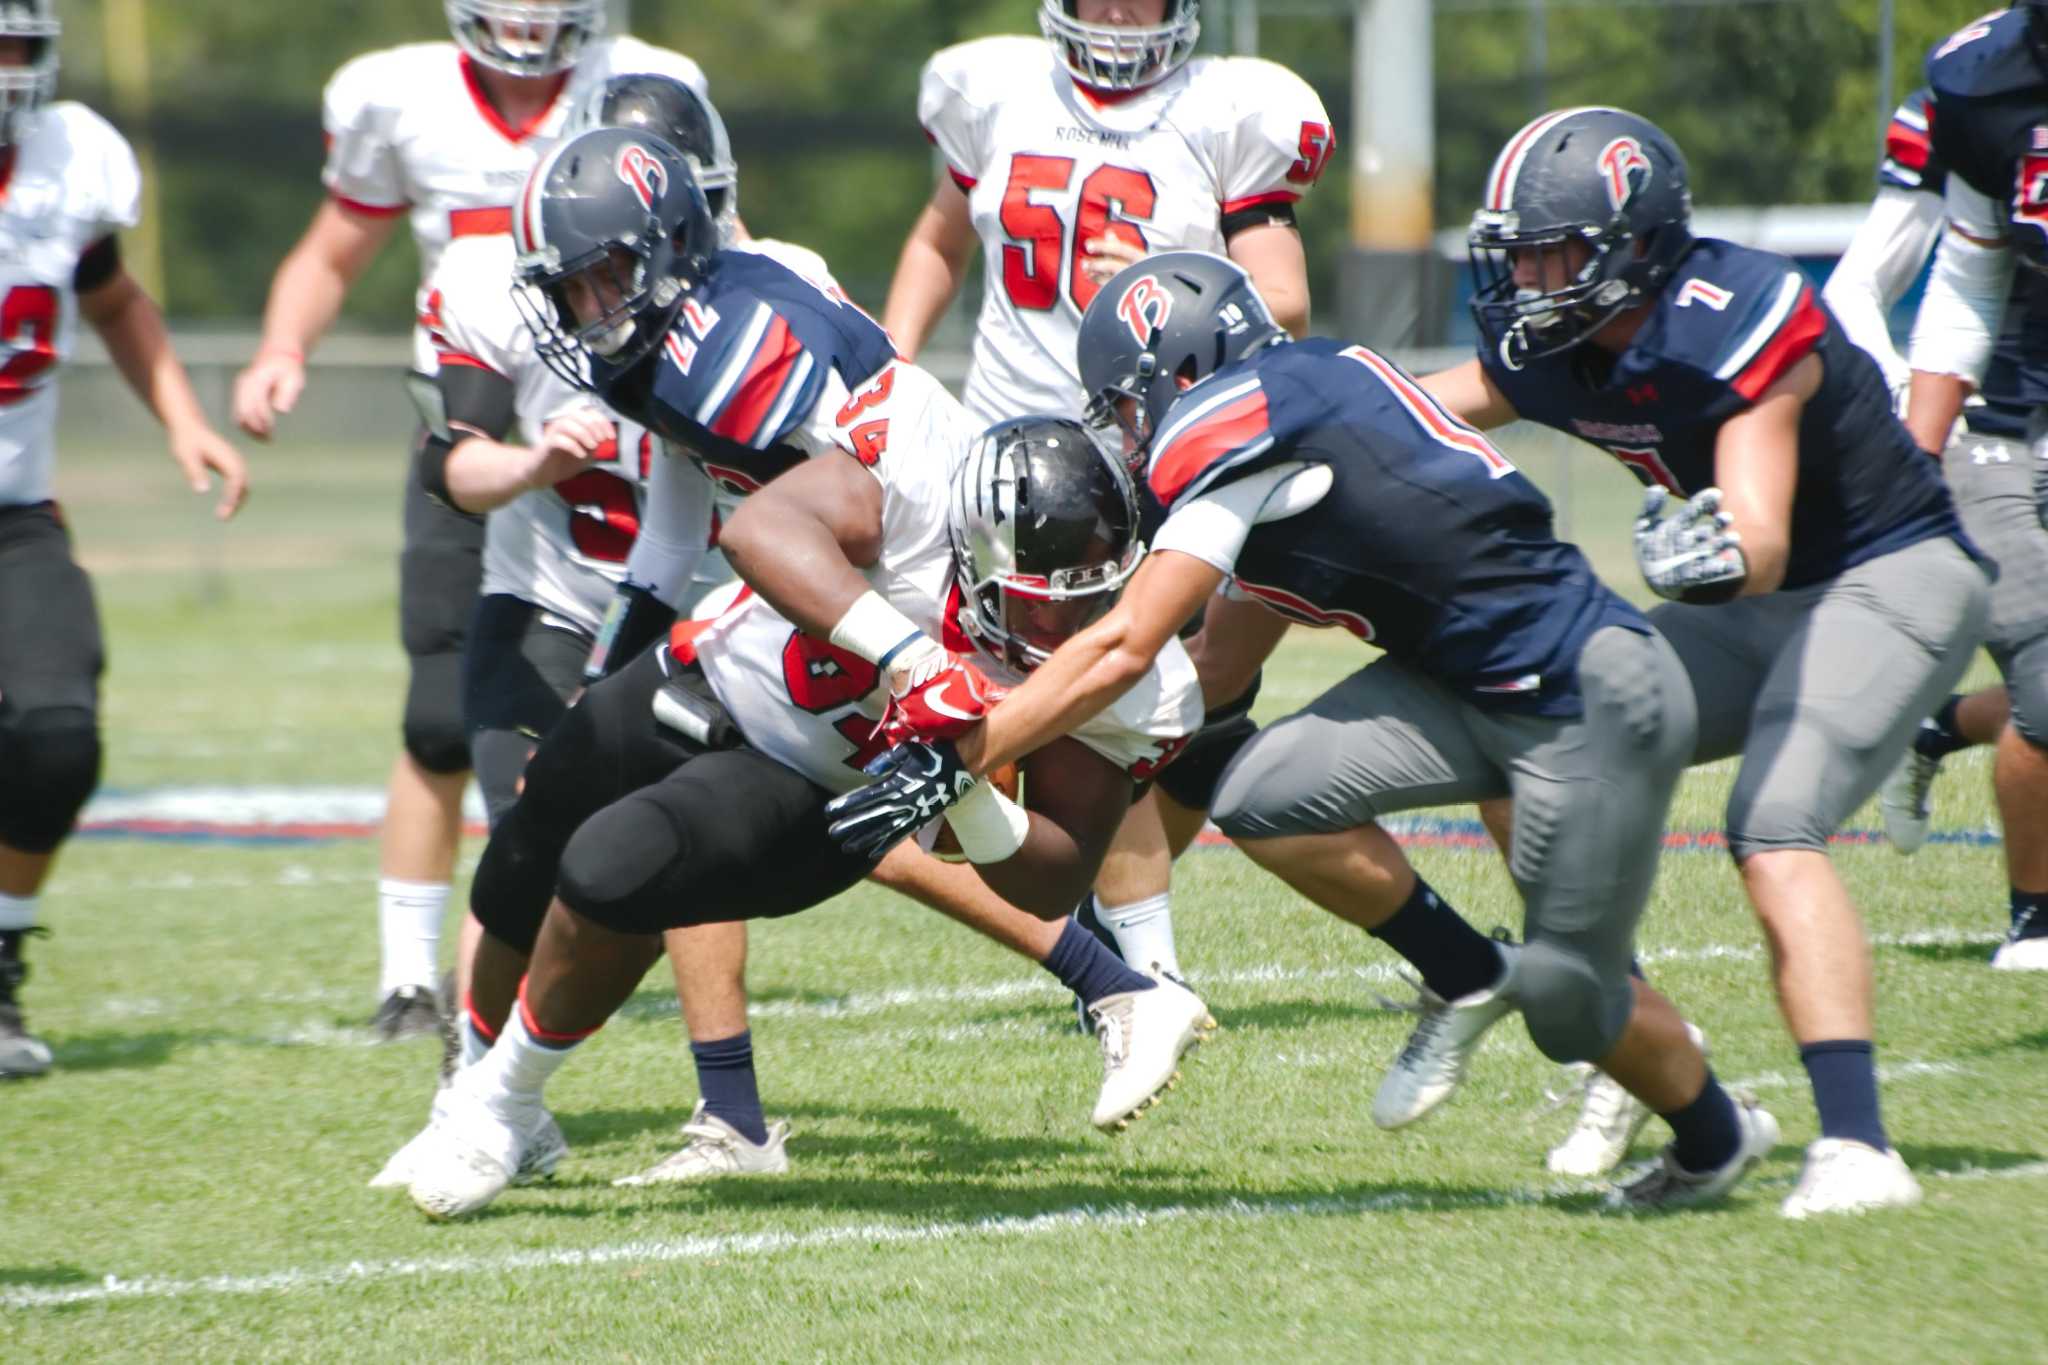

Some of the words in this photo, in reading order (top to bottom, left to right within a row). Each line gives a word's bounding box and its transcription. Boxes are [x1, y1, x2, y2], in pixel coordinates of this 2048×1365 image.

[1000, 153, 1158, 313] 56
[1116, 274, 1175, 350] B
[1675, 278, 1734, 312] 7
[663, 297, 721, 377] 22
[836, 366, 897, 467] 34
